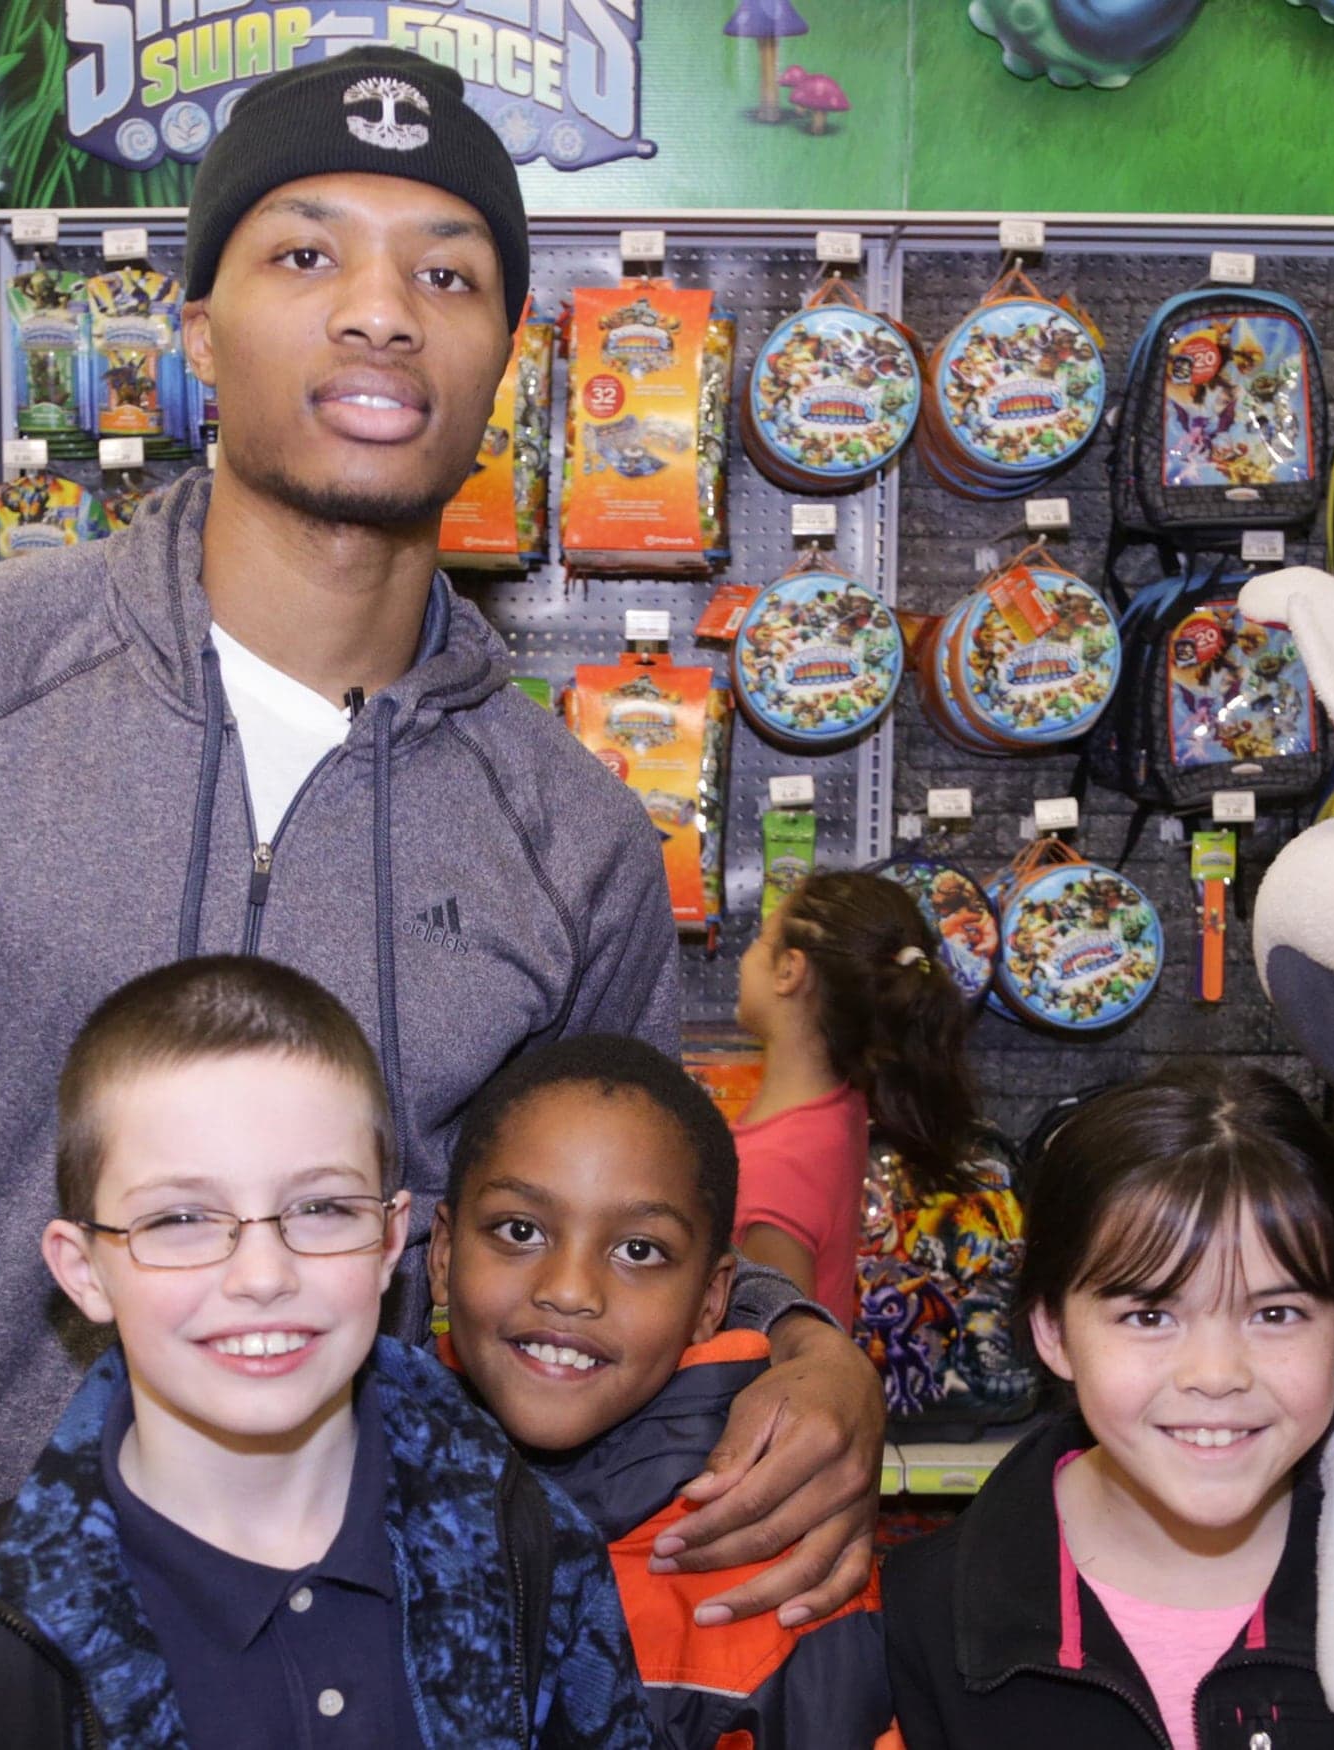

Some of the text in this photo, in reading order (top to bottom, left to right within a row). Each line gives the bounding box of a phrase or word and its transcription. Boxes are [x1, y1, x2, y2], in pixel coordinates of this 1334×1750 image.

[141, 7, 312, 107] SWAP
[387, 6, 563, 113] FORCE
[1194, 351, 1216, 368] 20
[591, 387, 617, 404] 32
[1195, 628, 1219, 648] 20
[402, 920, 467, 955] adidas
